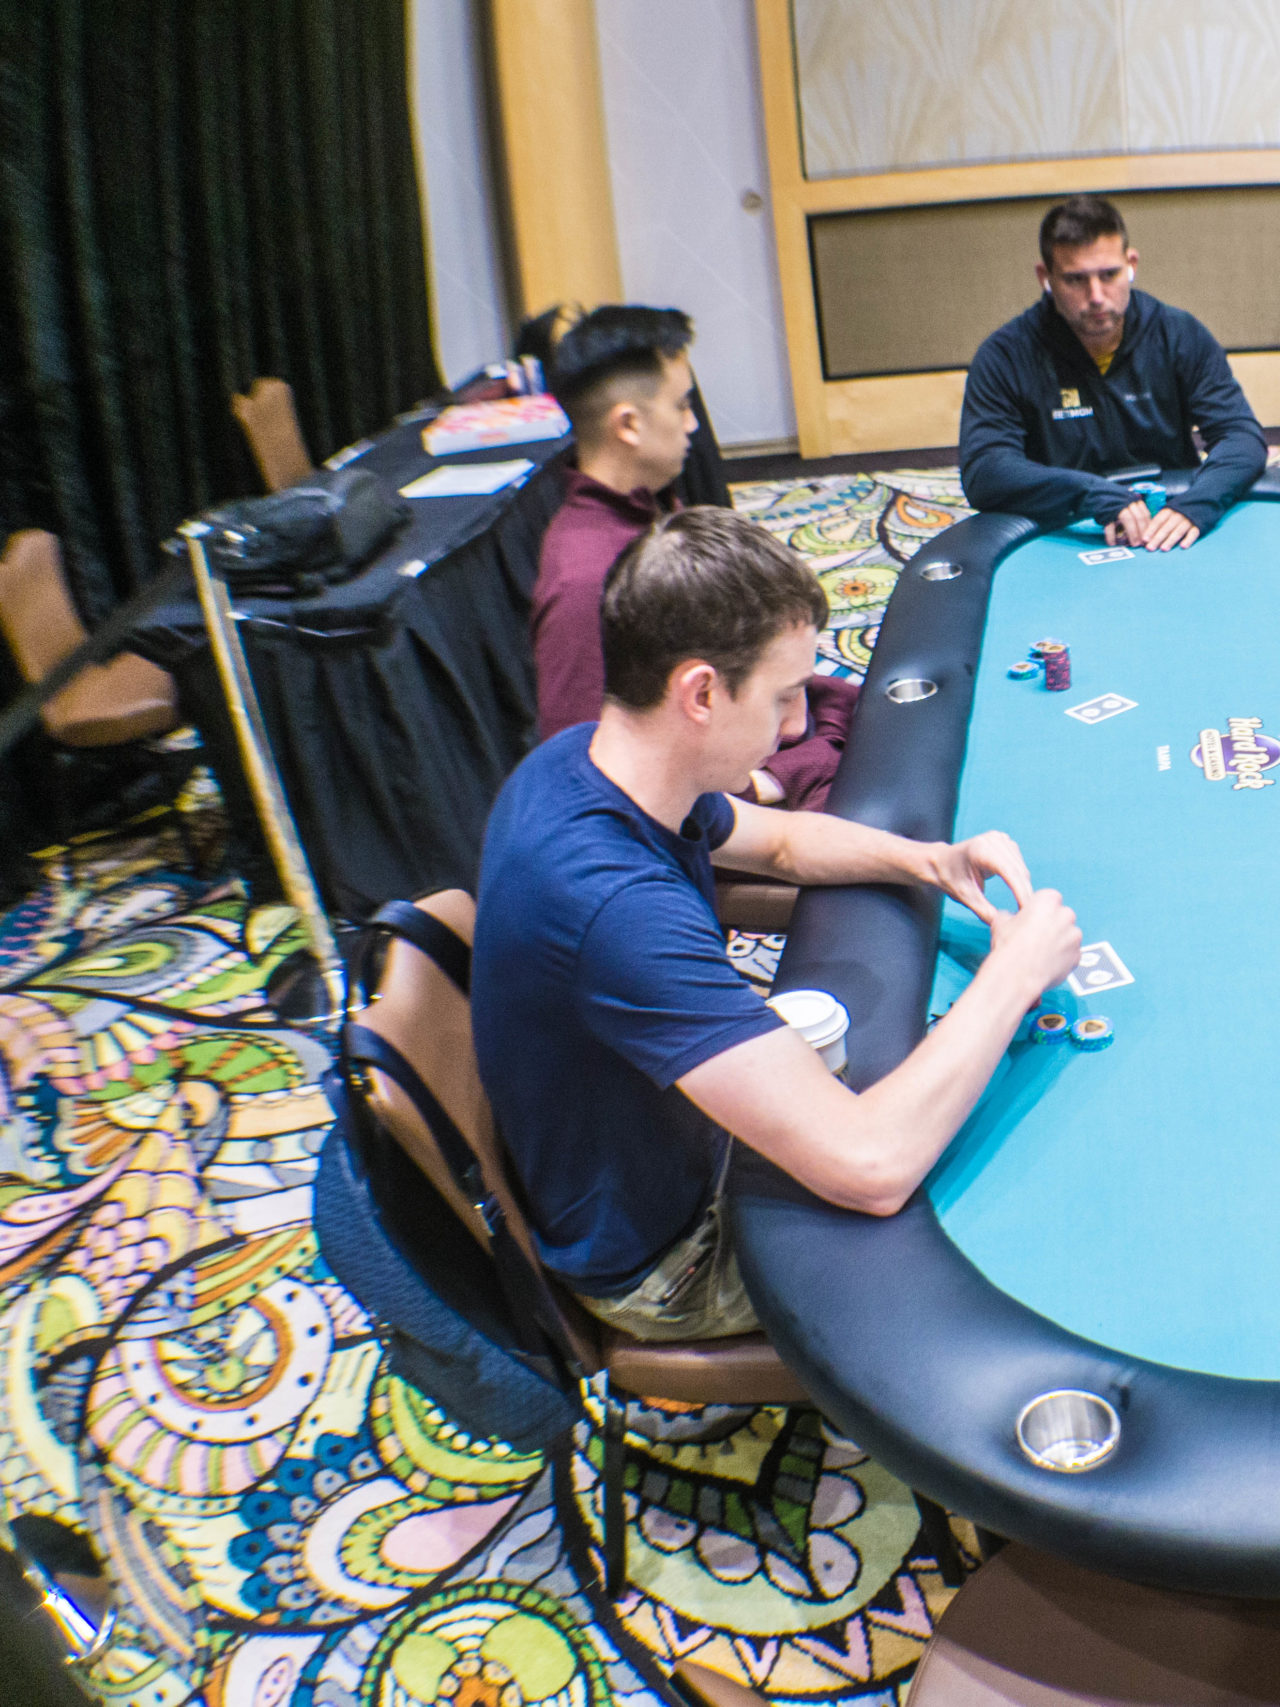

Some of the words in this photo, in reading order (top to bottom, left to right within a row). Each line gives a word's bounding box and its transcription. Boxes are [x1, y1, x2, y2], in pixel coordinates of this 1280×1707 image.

[1227, 717, 1267, 753] Hard
[1157, 745, 1171, 772] TAMPA
[1228, 752, 1275, 790] Rock
